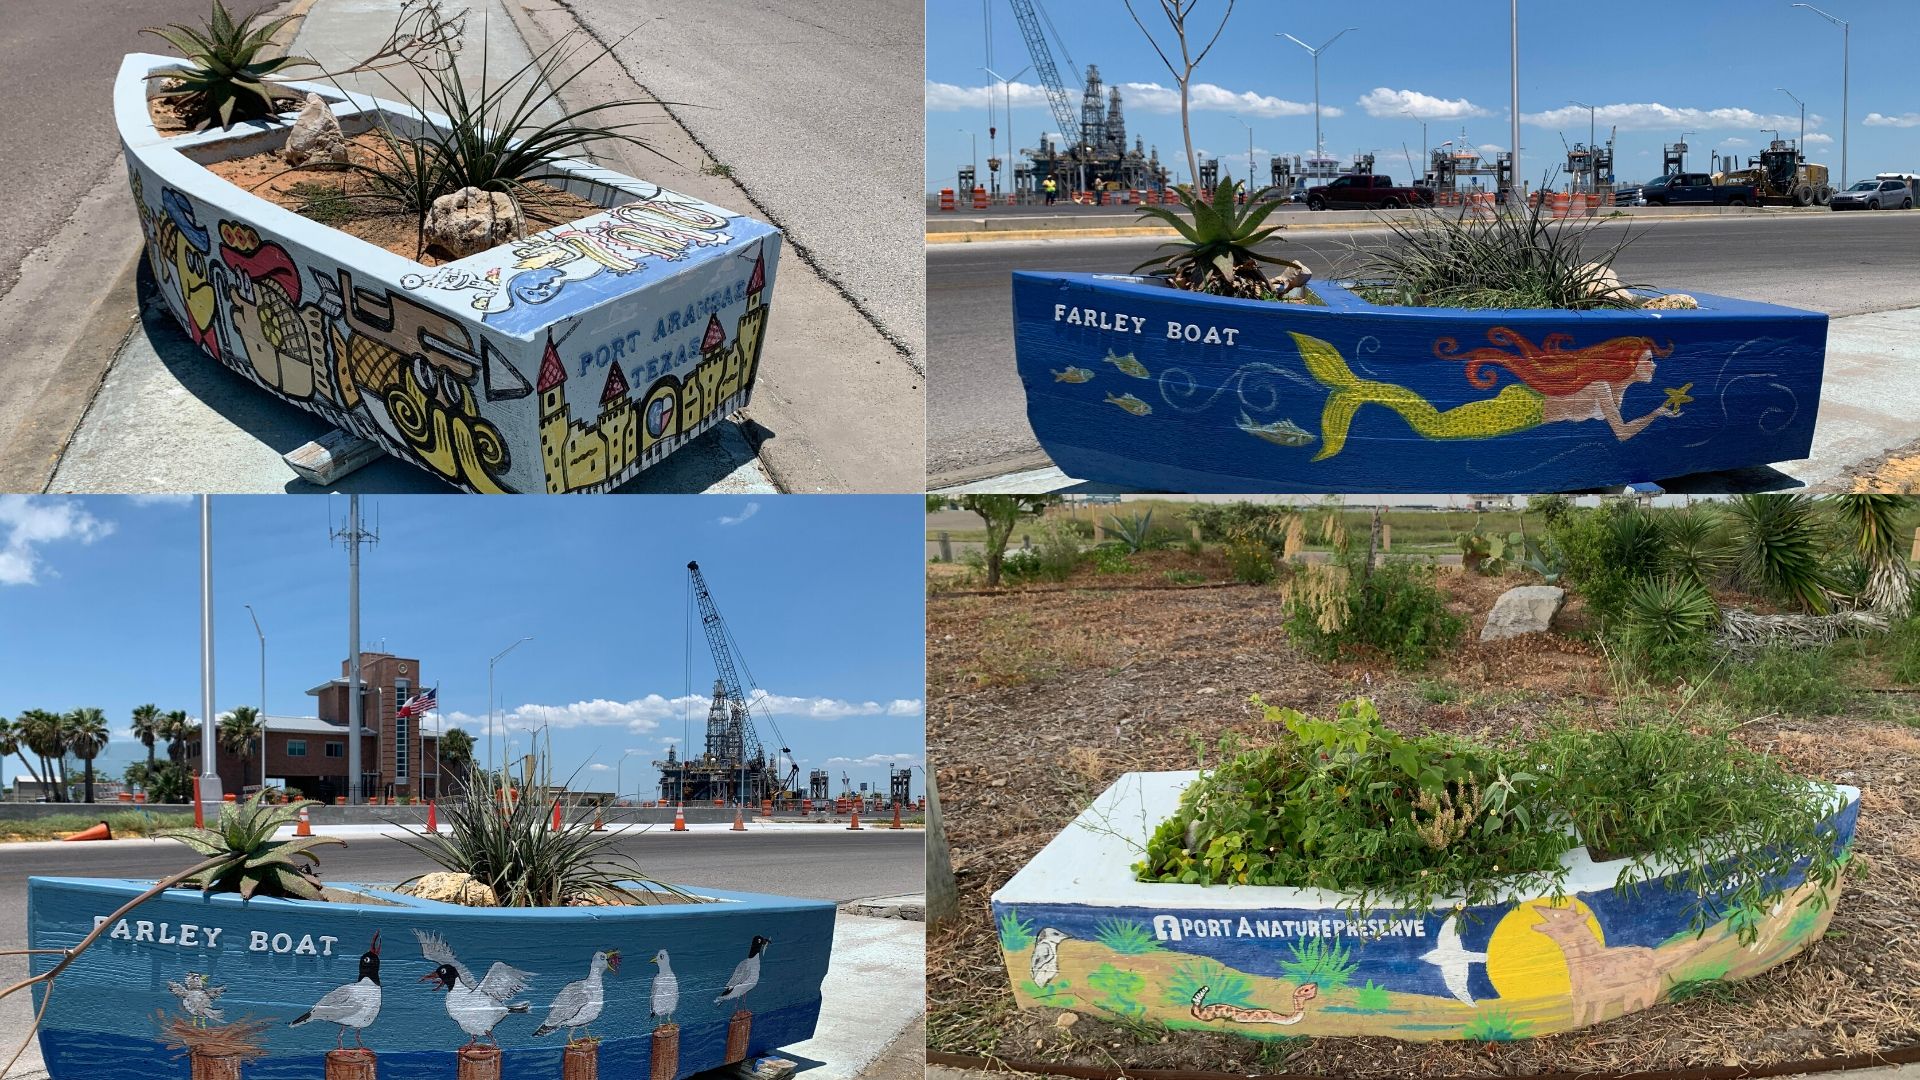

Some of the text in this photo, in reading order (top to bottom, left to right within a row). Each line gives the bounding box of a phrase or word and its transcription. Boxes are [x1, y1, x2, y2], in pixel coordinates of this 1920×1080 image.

[1054, 304, 1239, 346] FARLEY BOAT
[579, 329, 641, 377] PORT
[631, 337, 701, 389] TEXAS
[249, 930, 338, 956] BOAT
[1181, 918, 1232, 937] PORT
